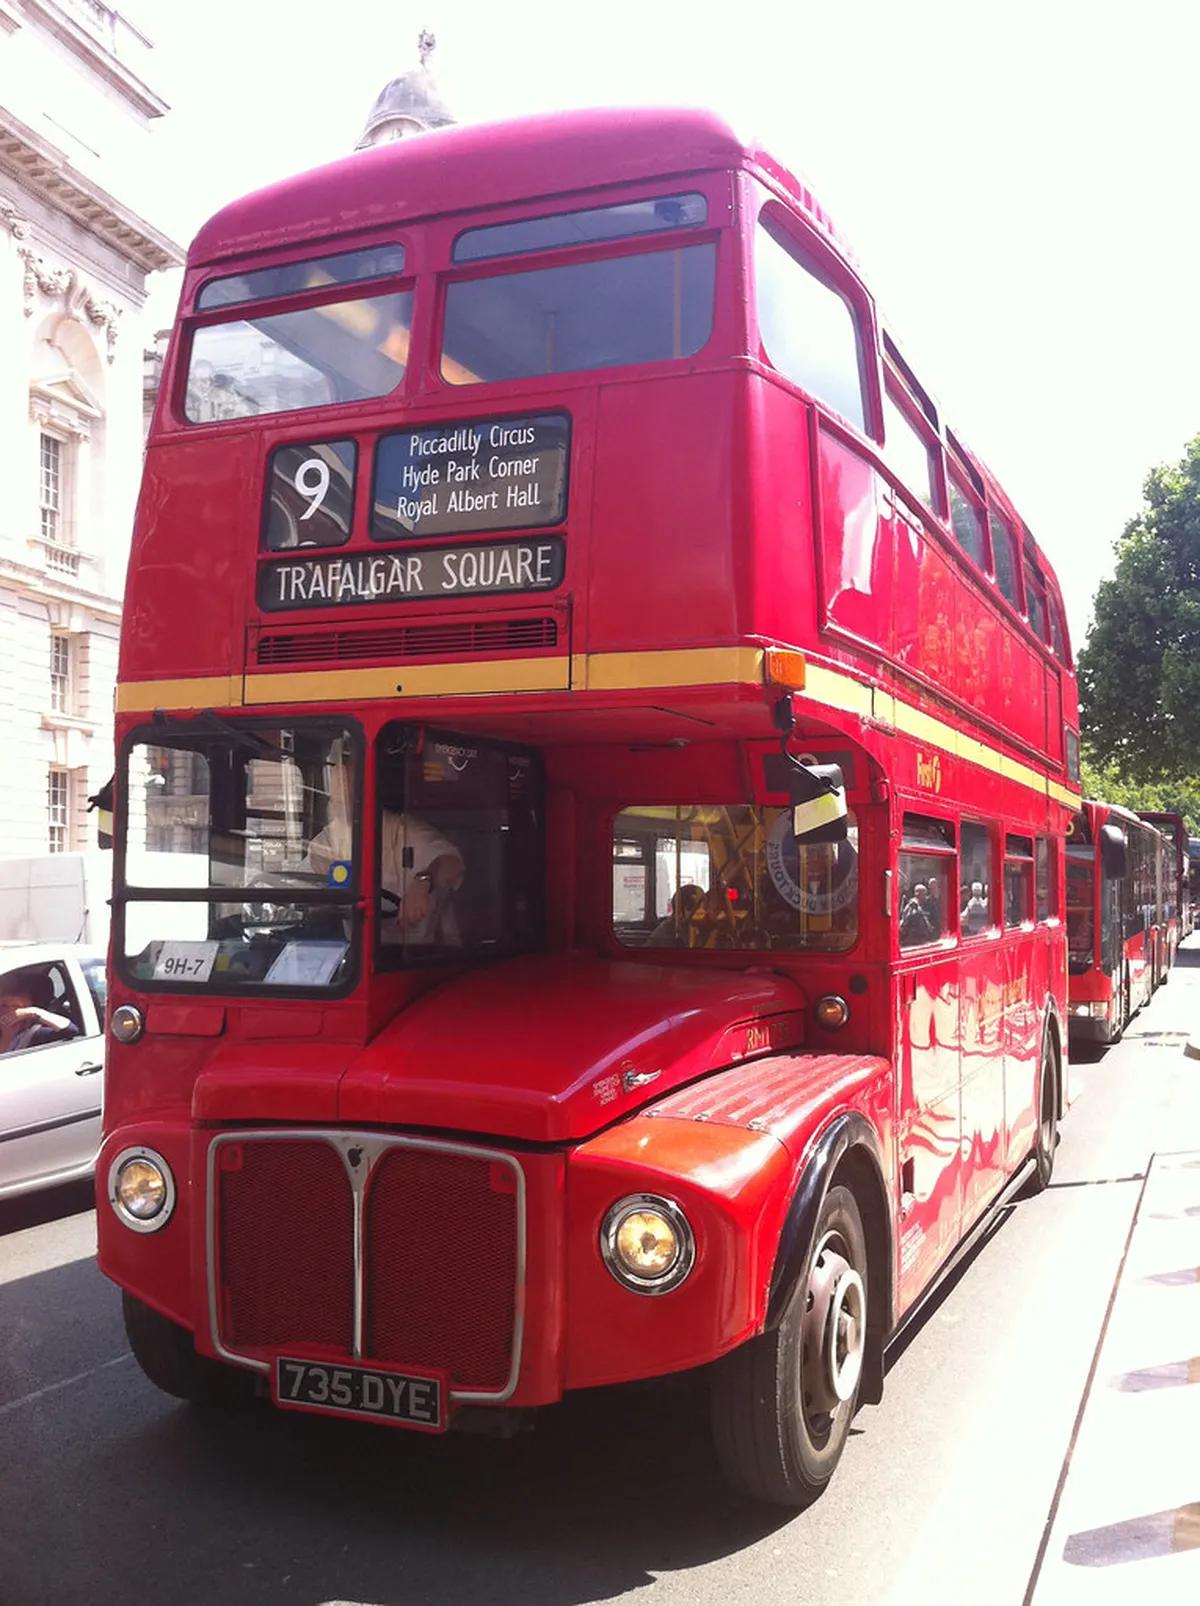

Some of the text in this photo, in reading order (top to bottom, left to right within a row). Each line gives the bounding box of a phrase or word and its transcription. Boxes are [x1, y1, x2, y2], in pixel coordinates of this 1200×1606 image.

[410, 426, 535, 456] Piccadilly Circus
[294, 458, 330, 521] 9
[403, 456, 539, 491] Hyde Park Corner
[397, 483, 541, 522] Royal Albert Hall
[277, 546, 552, 601] TRAFALGAR SQUARE
[164, 957, 204, 976] 9H-7
[285, 1363, 431, 1420] 735 DYE
